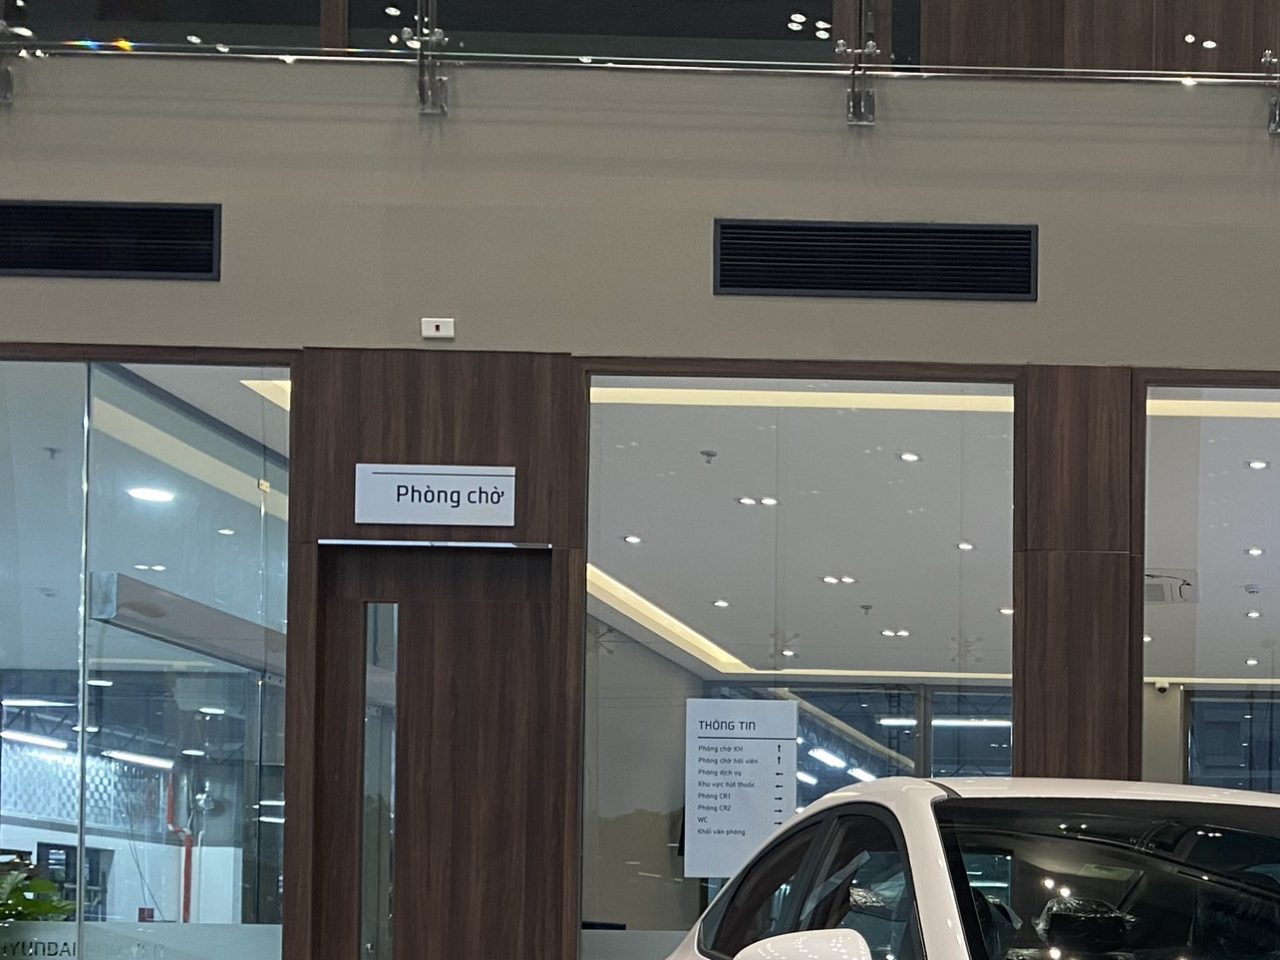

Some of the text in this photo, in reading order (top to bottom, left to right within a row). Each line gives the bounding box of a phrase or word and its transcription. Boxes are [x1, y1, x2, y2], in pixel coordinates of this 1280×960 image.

[397, 484, 505, 508] Phòng chờ
[698, 719, 756, 731] THÔNG TIN
